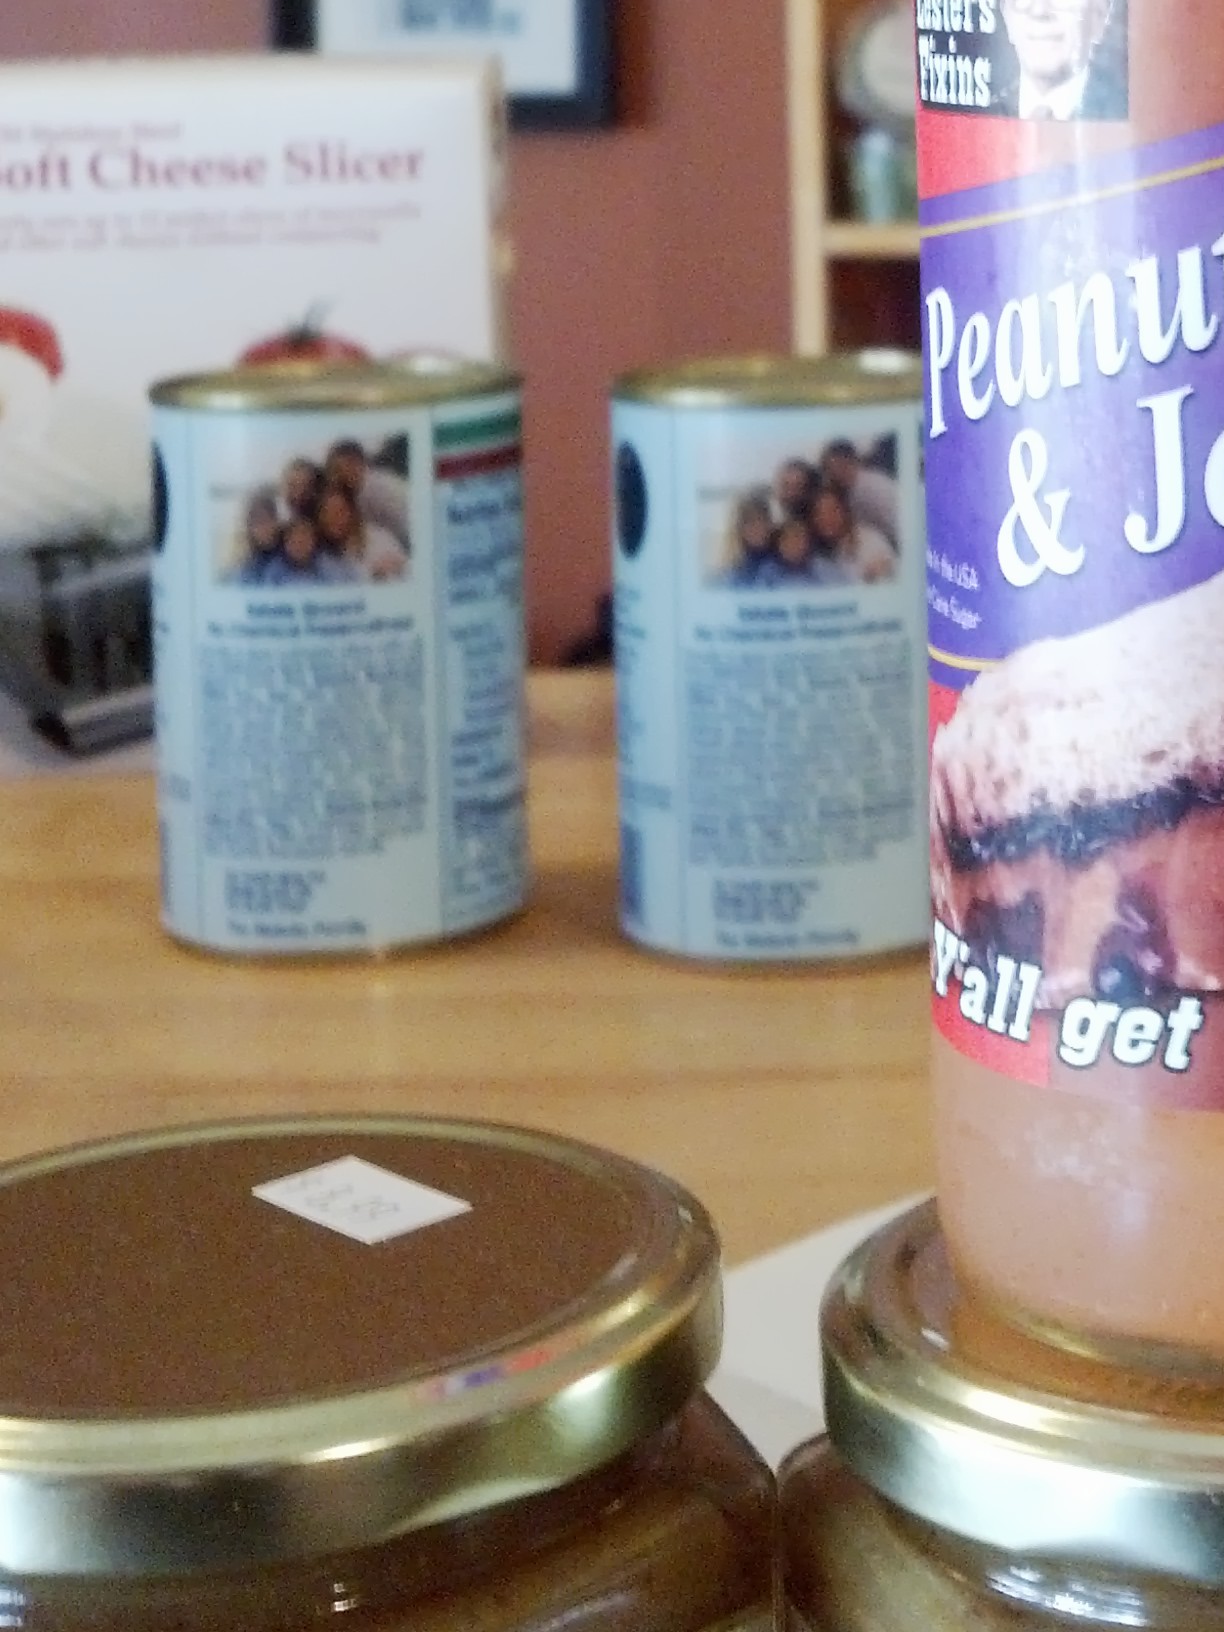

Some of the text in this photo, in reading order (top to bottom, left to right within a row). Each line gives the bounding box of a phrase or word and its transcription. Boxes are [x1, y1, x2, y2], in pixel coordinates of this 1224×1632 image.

[918, 34, 992, 108] Fixins
[0, 138, 425, 192] oft Cheese Slicer
[996, 428, 1086, 588] &
[933, 917, 1043, 1043] Y'all
[1057, 995, 1205, 1070] get
